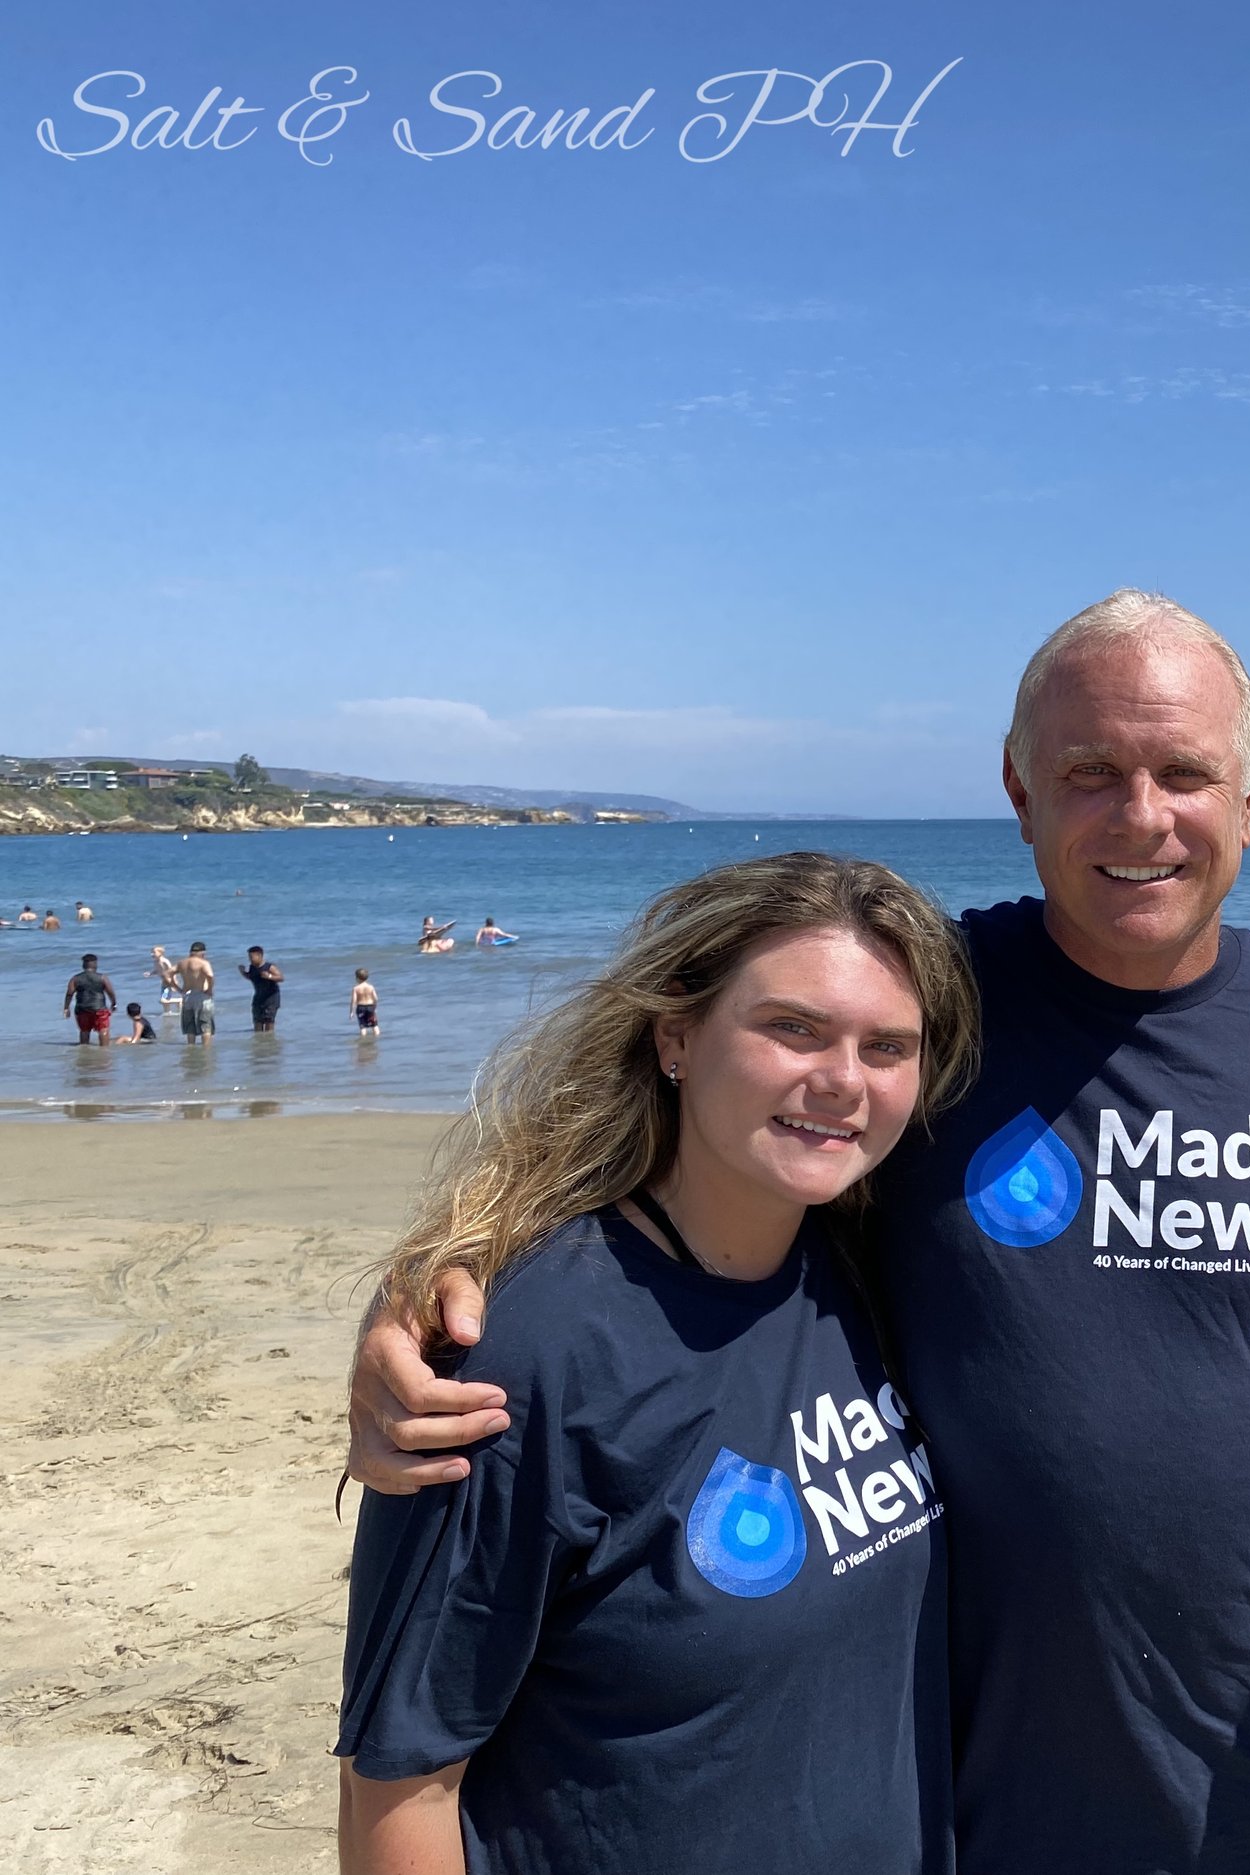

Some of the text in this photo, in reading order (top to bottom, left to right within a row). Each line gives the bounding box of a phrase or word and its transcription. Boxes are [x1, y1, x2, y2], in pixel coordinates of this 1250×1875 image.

[1092, 1254, 1112, 1268] 40
[1113, 1255, 1151, 1269] Years
[1153, 1257, 1169, 1270] of
[1171, 1257, 1232, 1274] Changed
[801, 1443, 936, 1557] New
[832, 1558, 847, 1577] 40
[845, 1552, 875, 1569] Years
[874, 1533, 889, 1552] of
[887, 1510, 931, 1544] Changed
